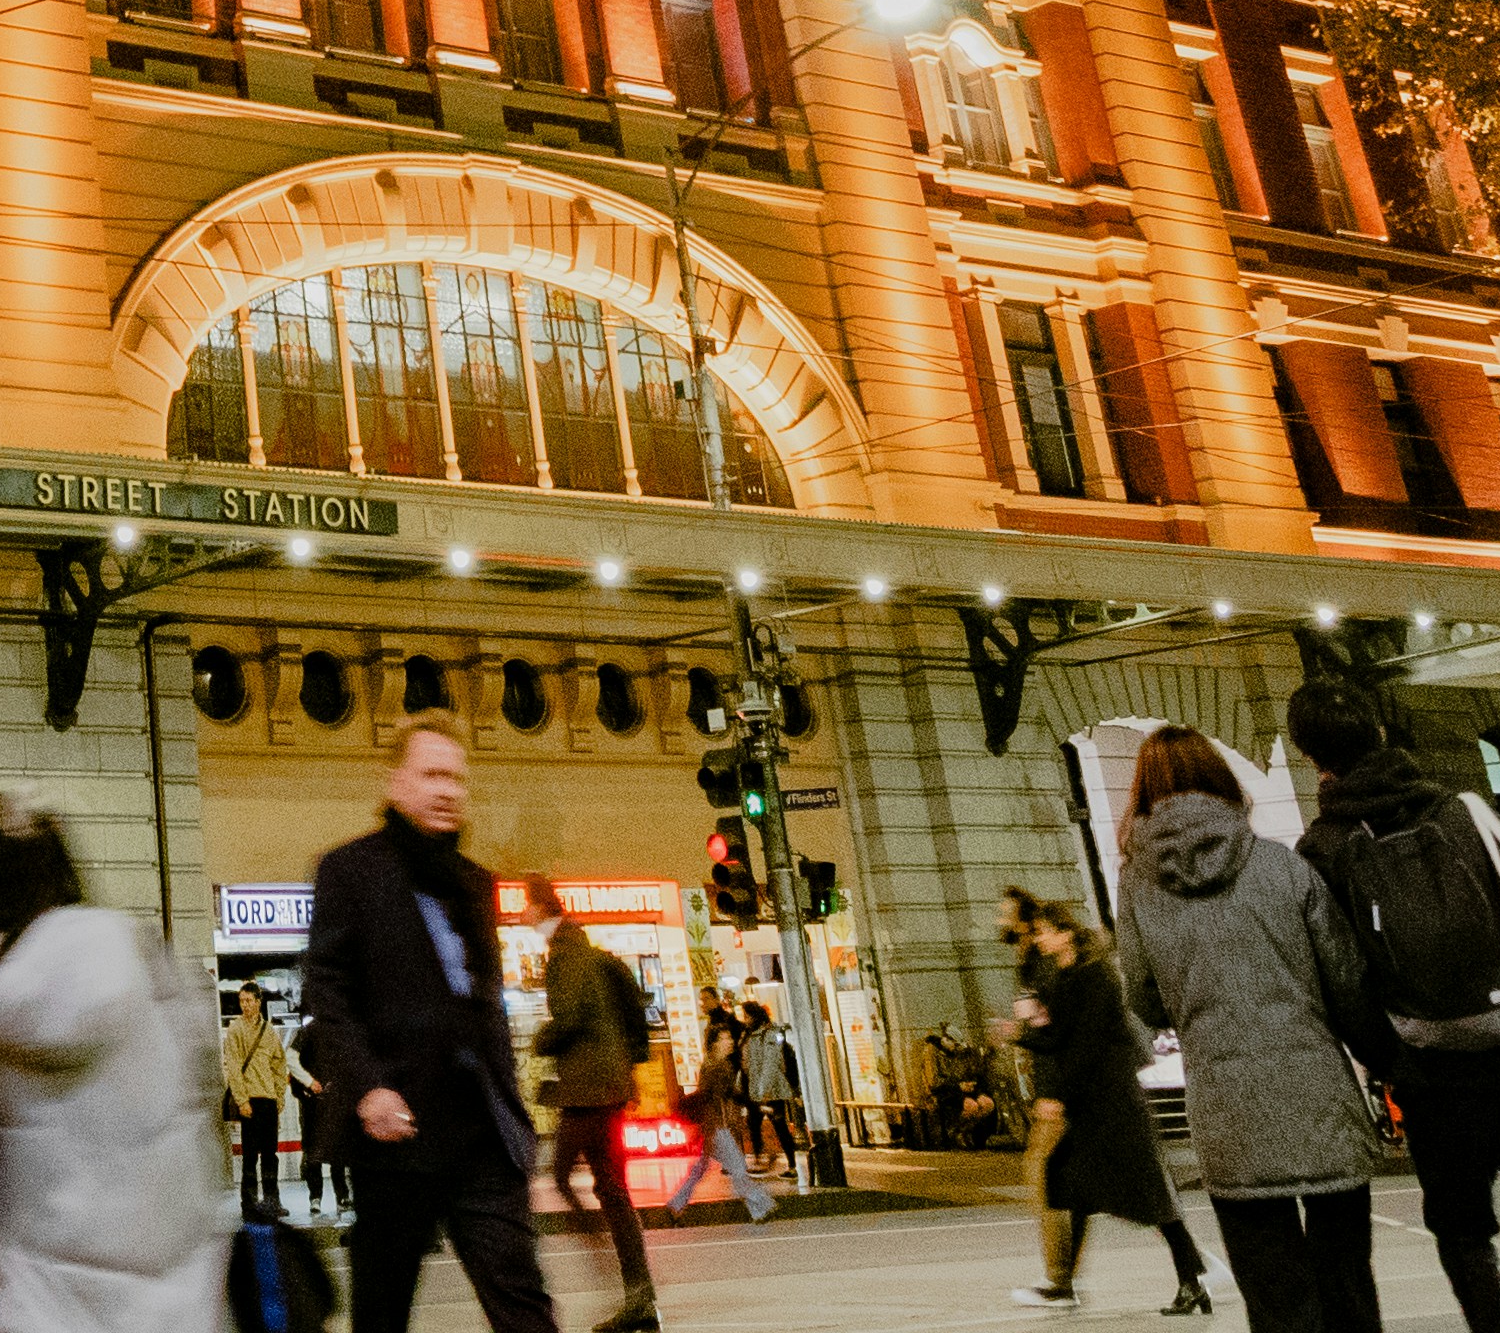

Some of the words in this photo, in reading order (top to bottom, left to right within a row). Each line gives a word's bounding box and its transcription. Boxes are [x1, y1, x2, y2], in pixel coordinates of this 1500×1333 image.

[37, 472, 166, 514] STREET
[223, 488, 370, 530] STATION
[226, 899, 276, 925] LORD
